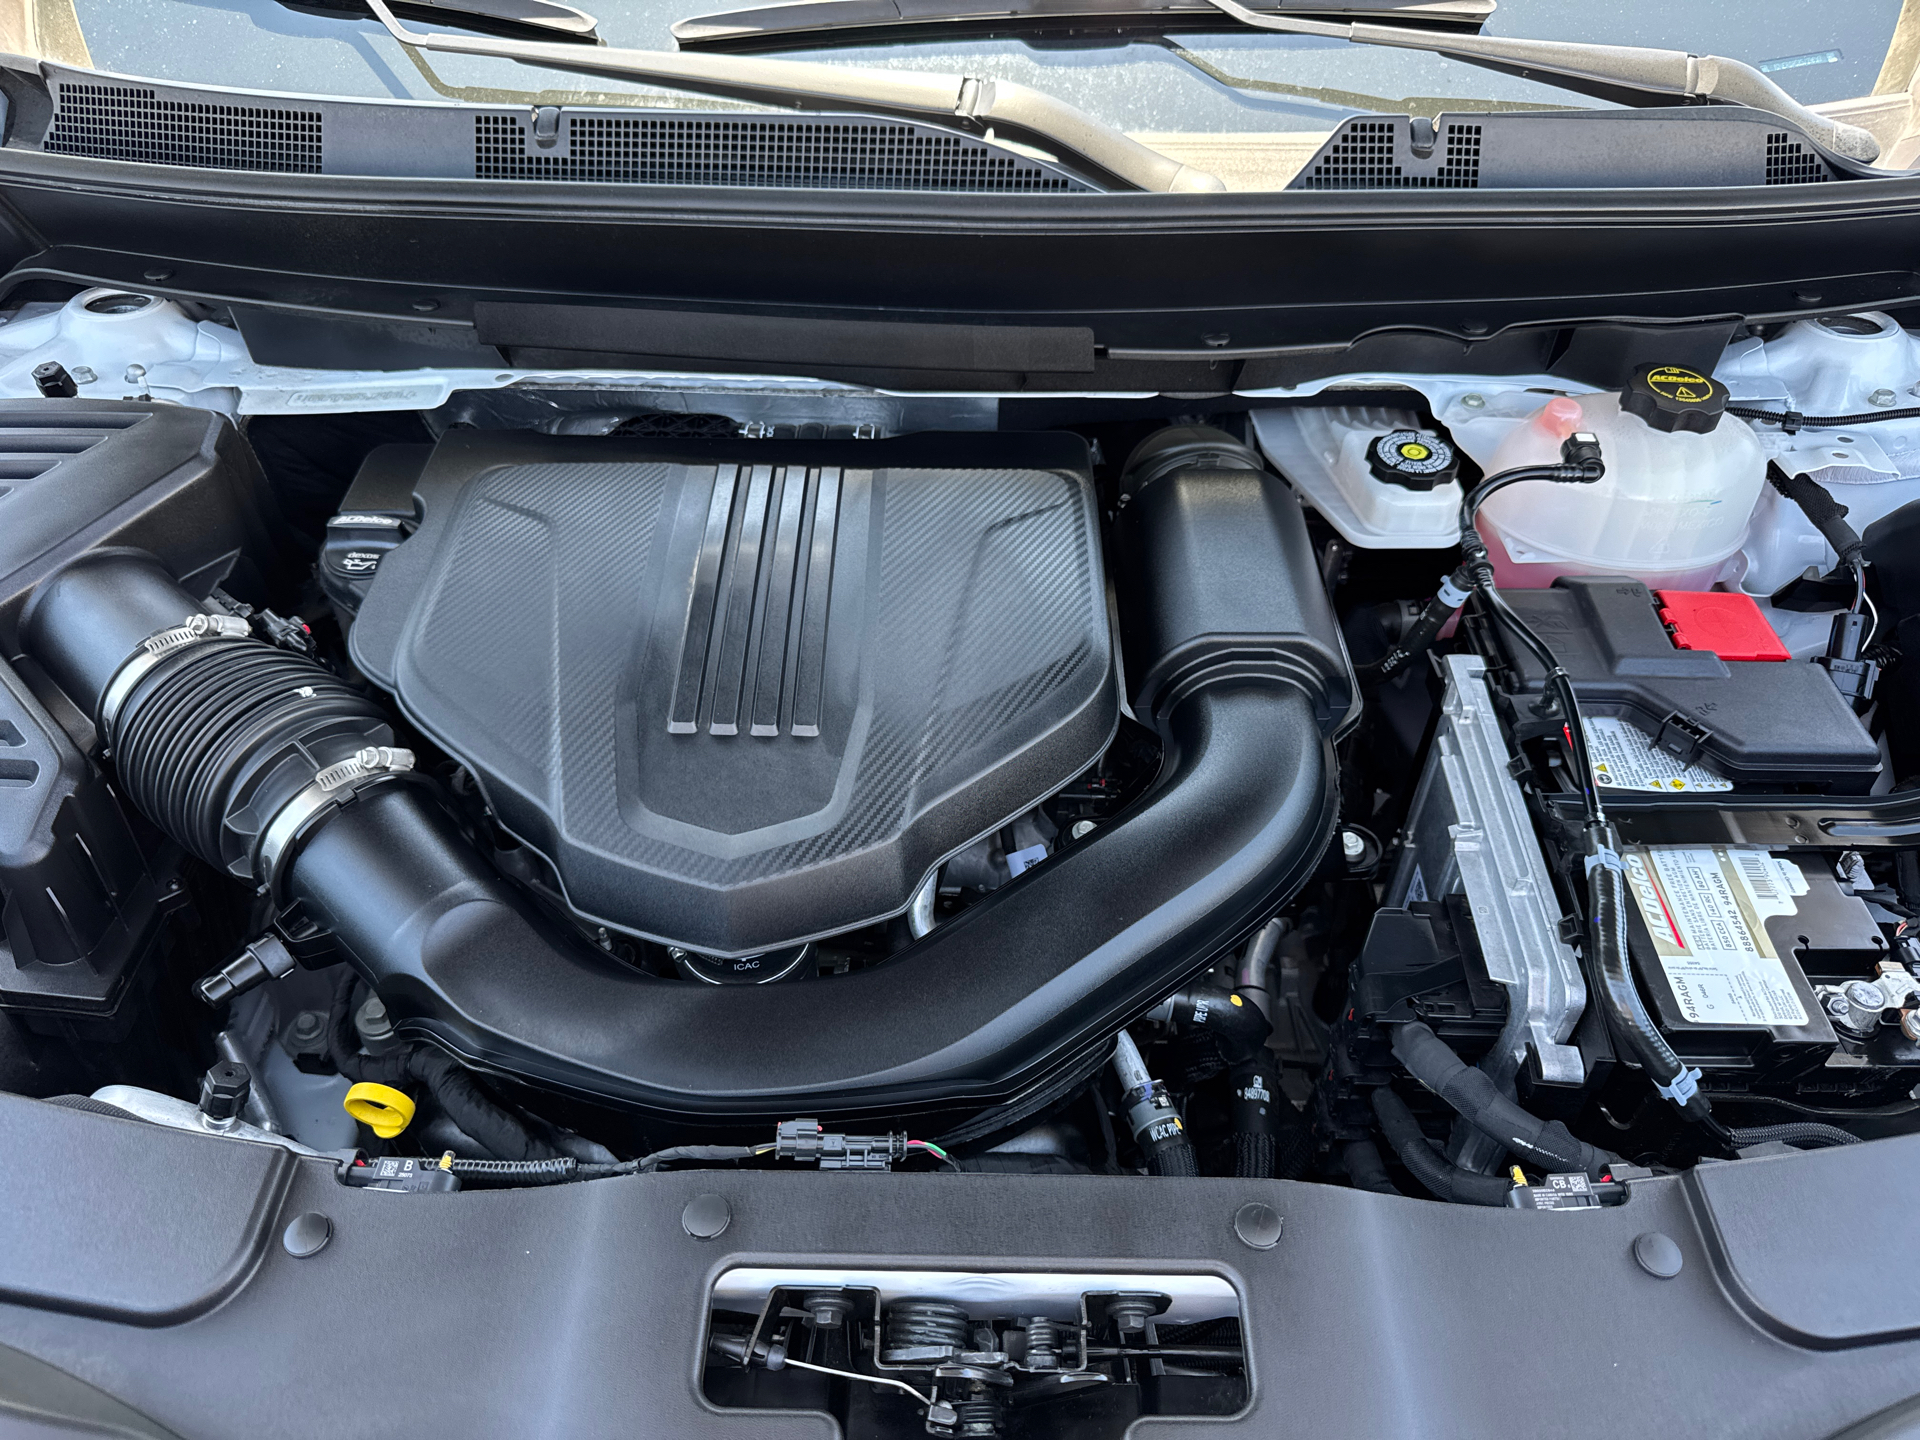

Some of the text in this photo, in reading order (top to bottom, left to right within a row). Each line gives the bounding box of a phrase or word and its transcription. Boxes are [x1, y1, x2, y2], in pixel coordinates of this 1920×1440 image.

[1651, 375, 1704, 383] ACDelco
[333, 515, 393, 525] ACDelco
[1678, 516, 1724, 531] MEXICO
[1666, 874, 1678, 888] FREE
[1671, 867, 1680, 878] AGM
[1673, 859, 1697, 900] MANTENIMIENTO
[1676, 880, 1693, 907] ENTRETIEN
[1711, 873, 1734, 905] 94RAGM
[1626, 854, 1676, 945] ACDelco
[1704, 895, 1718, 915] 140 RC
[1674, 890, 1699, 933] MAINTENANCE
[1689, 909, 1700, 922] SANS
[1696, 911, 1708, 926] LIBRE
[1696, 925, 1713, 950] BATTERIE
[1717, 923, 1733, 947] 850 CCA
[1728, 909, 1755, 952] 88864542
[734, 961, 760, 970] ICAC
[1674, 977, 1700, 1018] 94RAGM
[1149, 1124, 1169, 1142] WCAC
[403, 1160, 414, 1171] B
